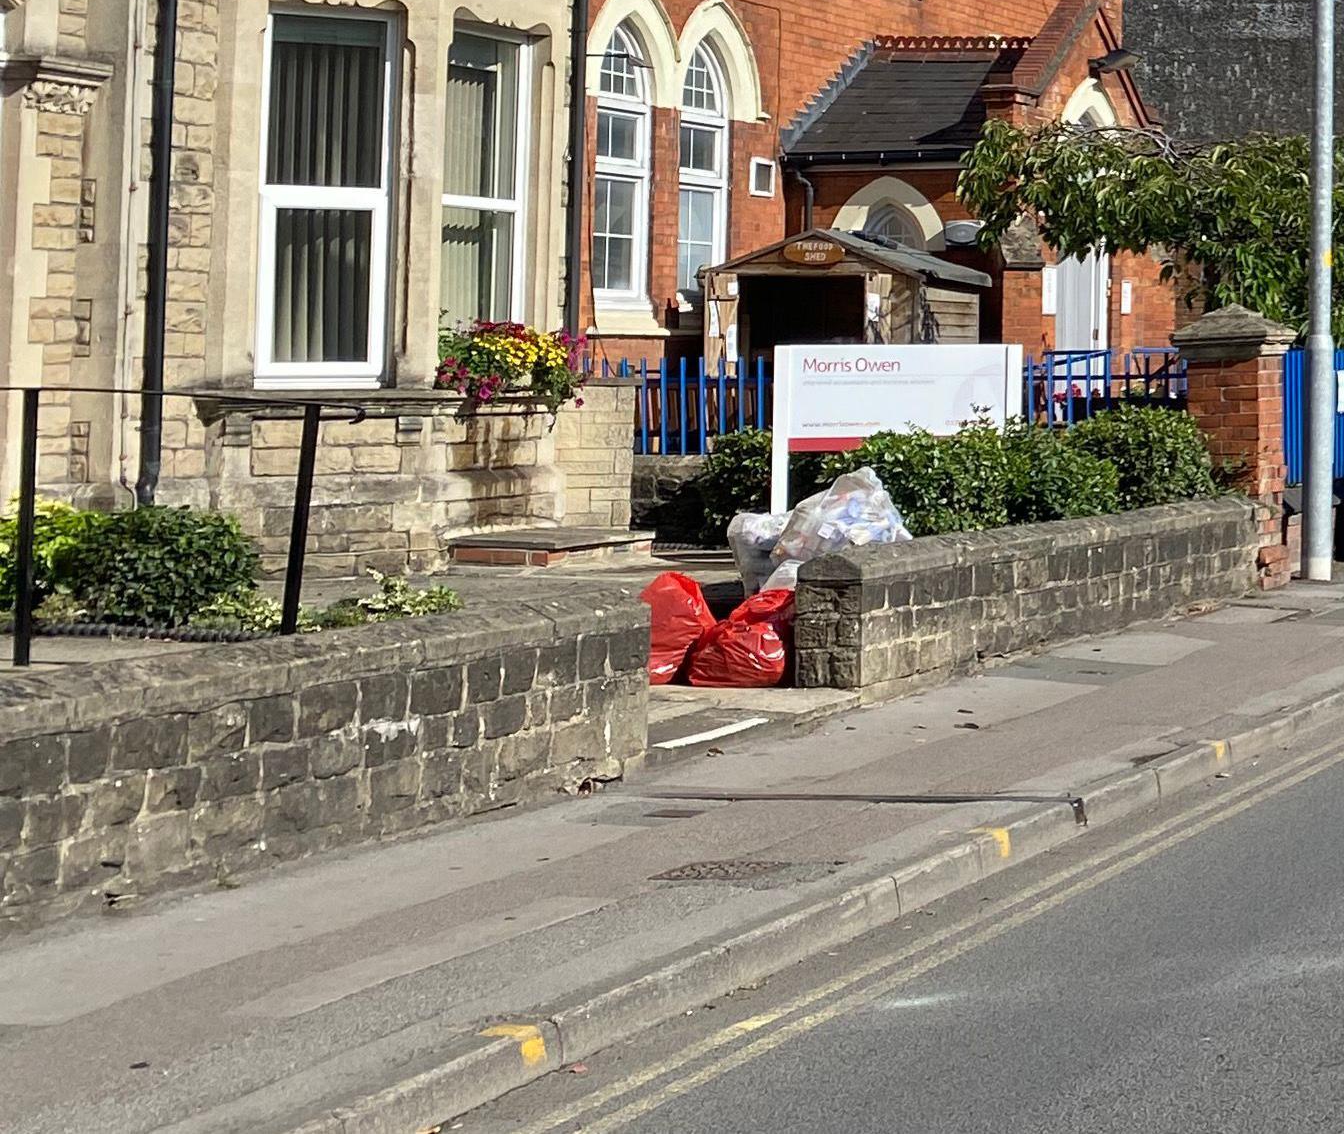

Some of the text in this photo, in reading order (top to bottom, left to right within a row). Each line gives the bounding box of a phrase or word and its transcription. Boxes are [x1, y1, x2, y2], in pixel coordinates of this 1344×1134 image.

[804, 252, 826, 261] SHED
[802, 357, 900, 373] Morris Owen
